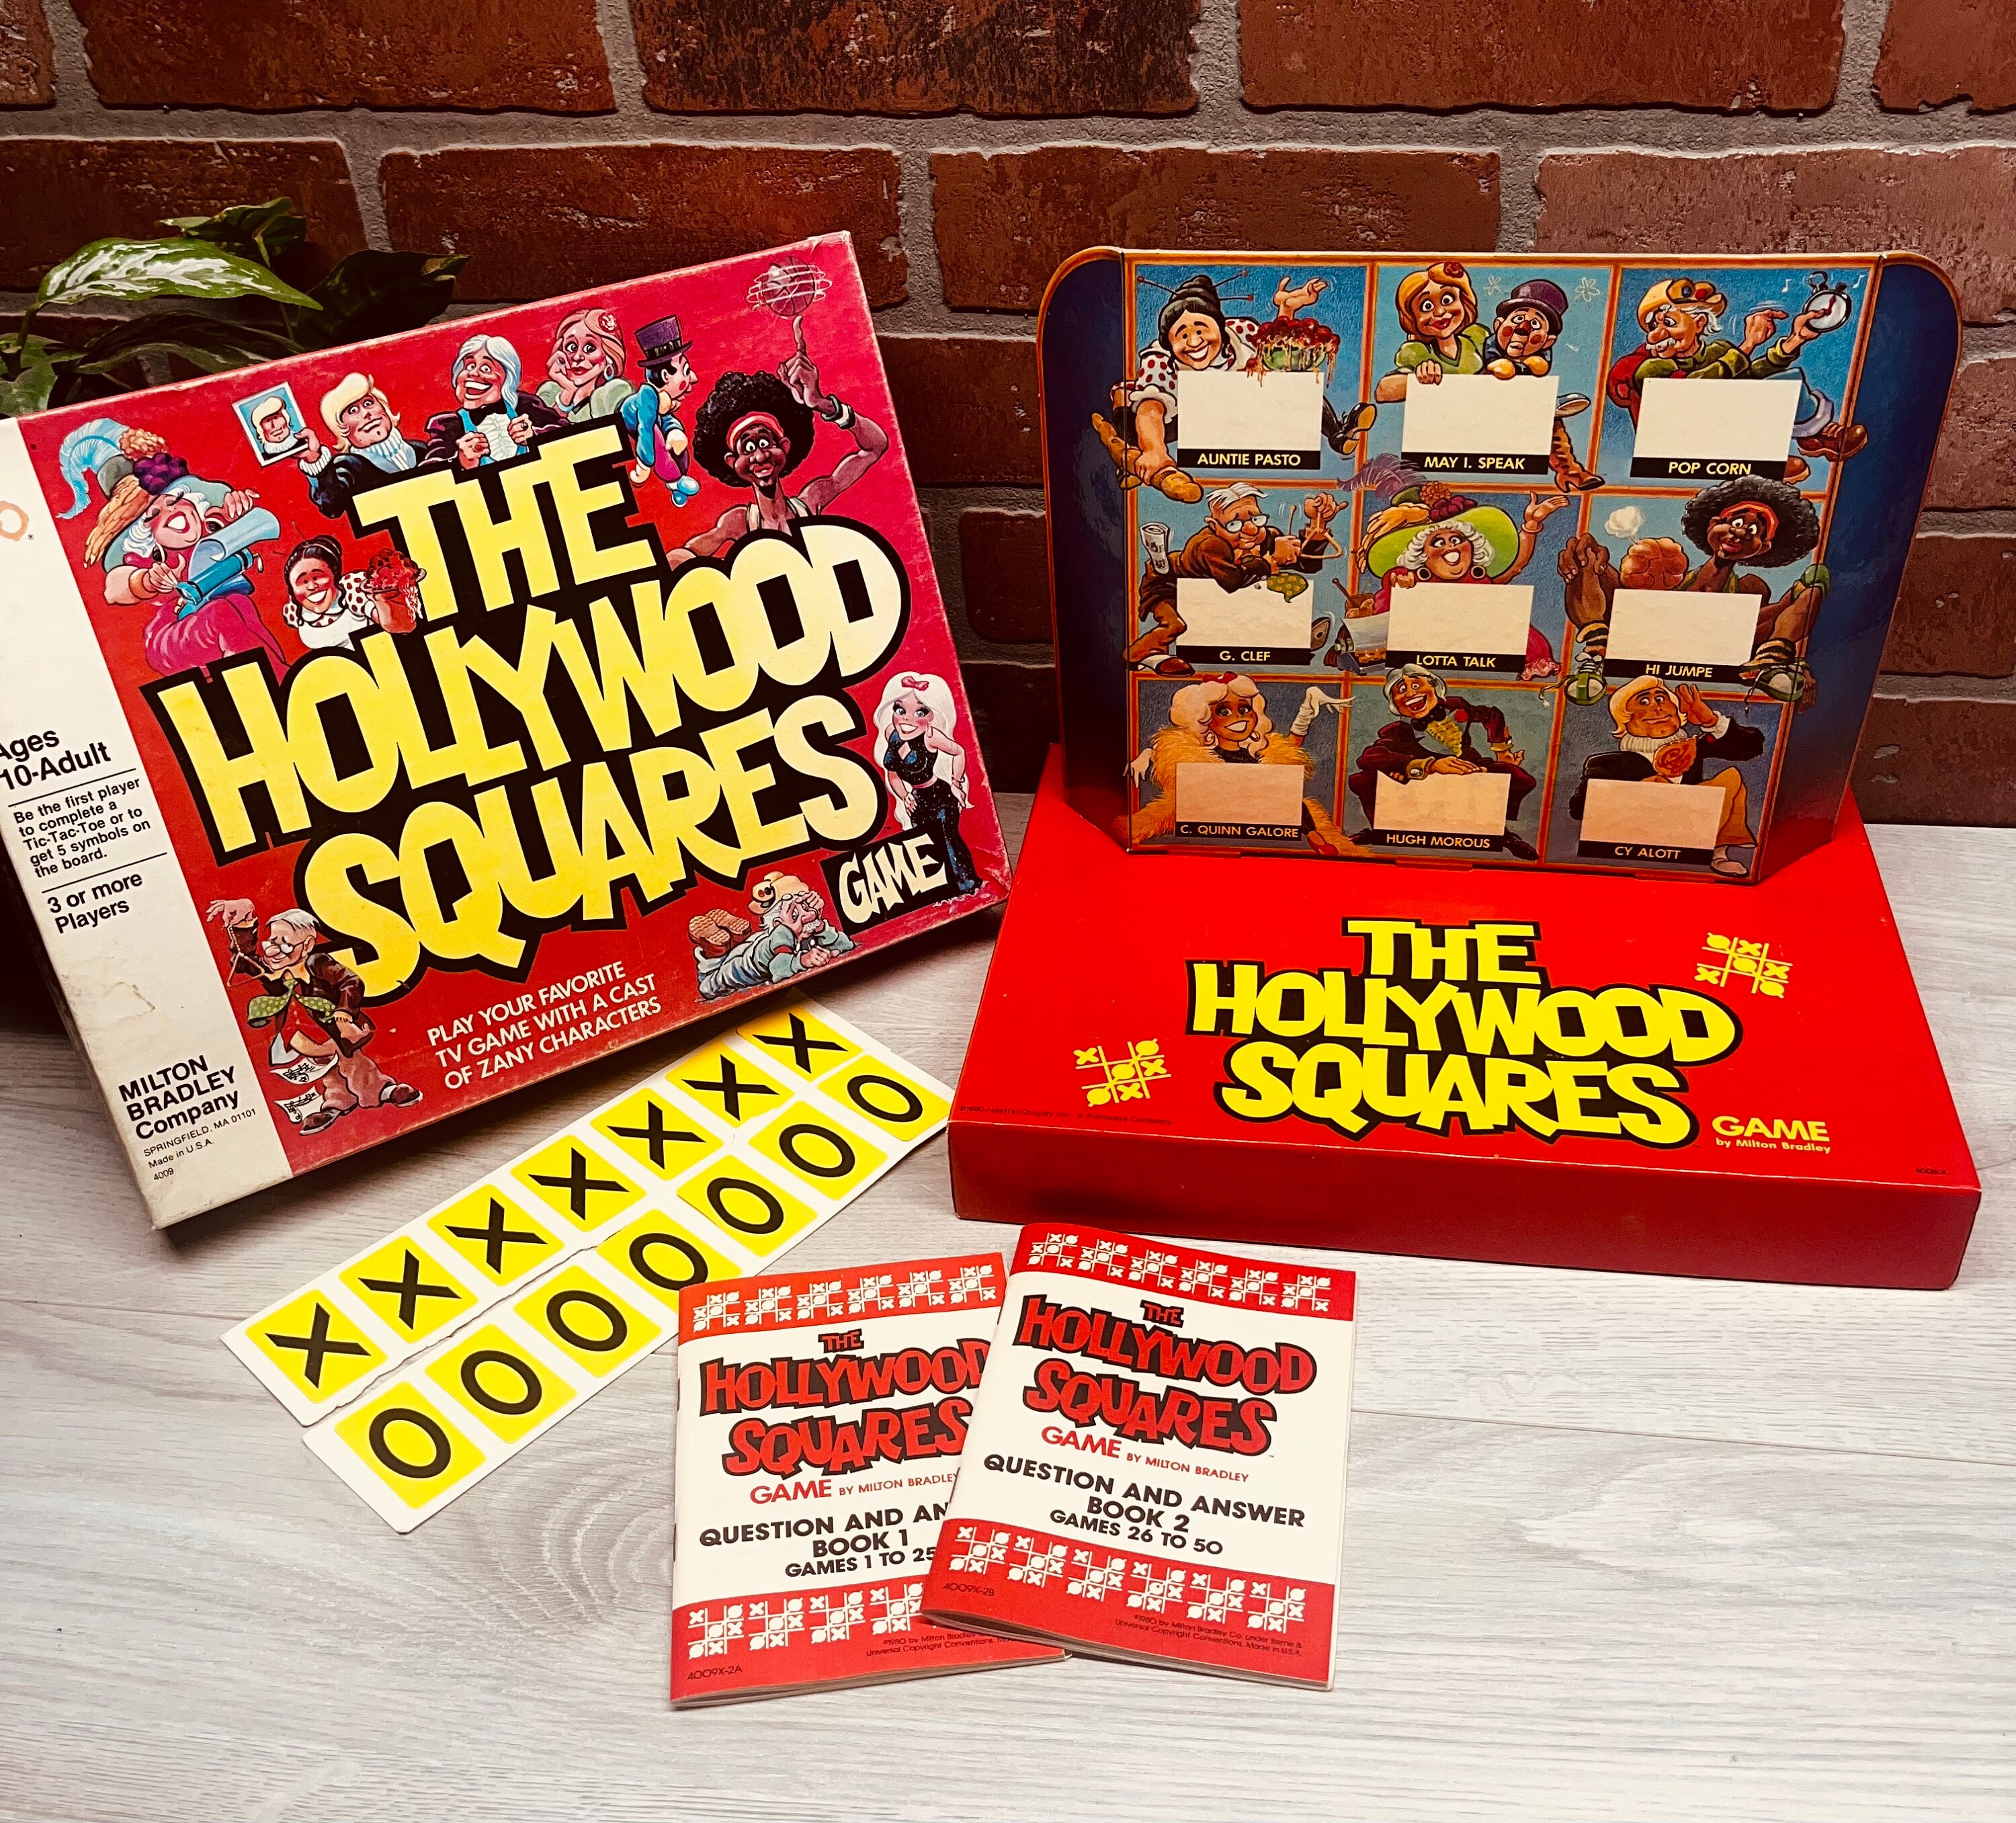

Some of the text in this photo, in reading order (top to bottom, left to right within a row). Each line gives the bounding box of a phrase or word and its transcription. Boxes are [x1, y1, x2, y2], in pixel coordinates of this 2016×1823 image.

[1197, 453, 1301, 466] AUNTIE PASTO
[1424, 456, 1525, 470] MAY I. SPEAK
[1668, 461, 1751, 476] POP CORN
[351, 425, 657, 622] THE
[1220, 650, 1271, 663] G. CLEF
[1416, 654, 1496, 668] LOTTA TALK
[1646, 665, 1712, 678] HI JUMPE
[158, 525, 901, 851] HOLLYWOOD
[0, 730, 60, 762] Ages
[0, 742, 111, 790] 10-Adult
[13, 778, 140, 824] Be the first player
[19, 801, 117, 837] to complete a
[24, 808, 143, 851] Tic-Tac-Toe or to
[30, 820, 151, 867] get 5 symbols on
[304, 695, 878, 998] SQUARES
[1180, 824, 1299, 839] C. QUINN GALORE
[1386, 833, 1490, 849] HUGH MOROUS
[34, 851, 108, 878] the board.
[1615, 846, 1681, 859] CY ALOTT
[48, 874, 142, 913] 3 or more
[839, 833, 948, 924] GAME
[55, 899, 130, 933] Players
[1347, 921, 1541, 984] THE
[427, 961, 626, 1046] PLAY YOUR FAVORITE
[435, 974, 656, 1067] TV GAME WITH A CAST
[1193, 963, 1735, 1062] HOLLYWOOD
[445, 997, 661, 1089] OF ZANY CHARACTERS
[118, 1054, 208, 1102] MILTON
[126, 1066, 235, 1121] BRADLEY
[1221, 1042, 1691, 1144] SQUARES
[135, 1091, 239, 1139] Company
[144, 1108, 256, 1156] SPRINGFIELD, MA 01101
[1712, 1115, 1830, 1142] GAME
[149, 1138, 214, 1169] Made in U.S.A.
[1716, 1138, 1831, 1154] by Milton Bradley
[154, 1168, 174, 1180] 4009
[265, 1012, 848, 1388] X X X X X X X
[1144, 1303, 1181, 1324] THE
[821, 1330, 862, 1351] THE
[1019, 1298, 1314, 1392] HOLLYWOOD
[706, 1341, 991, 1411] HOLLYWOOD
[1025, 1361, 1274, 1454] SQUARES
[726, 1399, 972, 1474] SQUARES
[1041, 1426, 1249, 1482] GAME BY MILTON BRADLEY
[750, 1473, 959, 1504] GAME BY MILTON BRADLEY
[984, 1454, 1305, 1527] QUESTION AND ANSWER
[700, 1517, 834, 1547] QUESTION
[844, 1508, 903, 1532] AND
[1050, 1509, 1223, 1555] GAMES 26 TO 50
[1087, 1496, 1190, 1533] BOOK 2
[785, 1547, 936, 1577] GAMES 1 TO 25
[812, 1529, 908, 1558] BOOK 1
[943, 1582, 995, 1597] 4009X-2B
[866, 1646, 900, 1656] Universal
[903, 1642, 942, 1653] Copyright
[921, 1634, 945, 1642] Milton
[1116, 1619, 1149, 1631] Universal
[1151, 1625, 1191, 1638] Copyright
[1246, 1642, 1270, 1652] Made
[1171, 1621, 1195, 1631] Milton
[1198, 1625, 1227, 1637] Bradley
[1245, 1634, 1269, 1643] under
[687, 1665, 743, 1680] 4009X-2A
